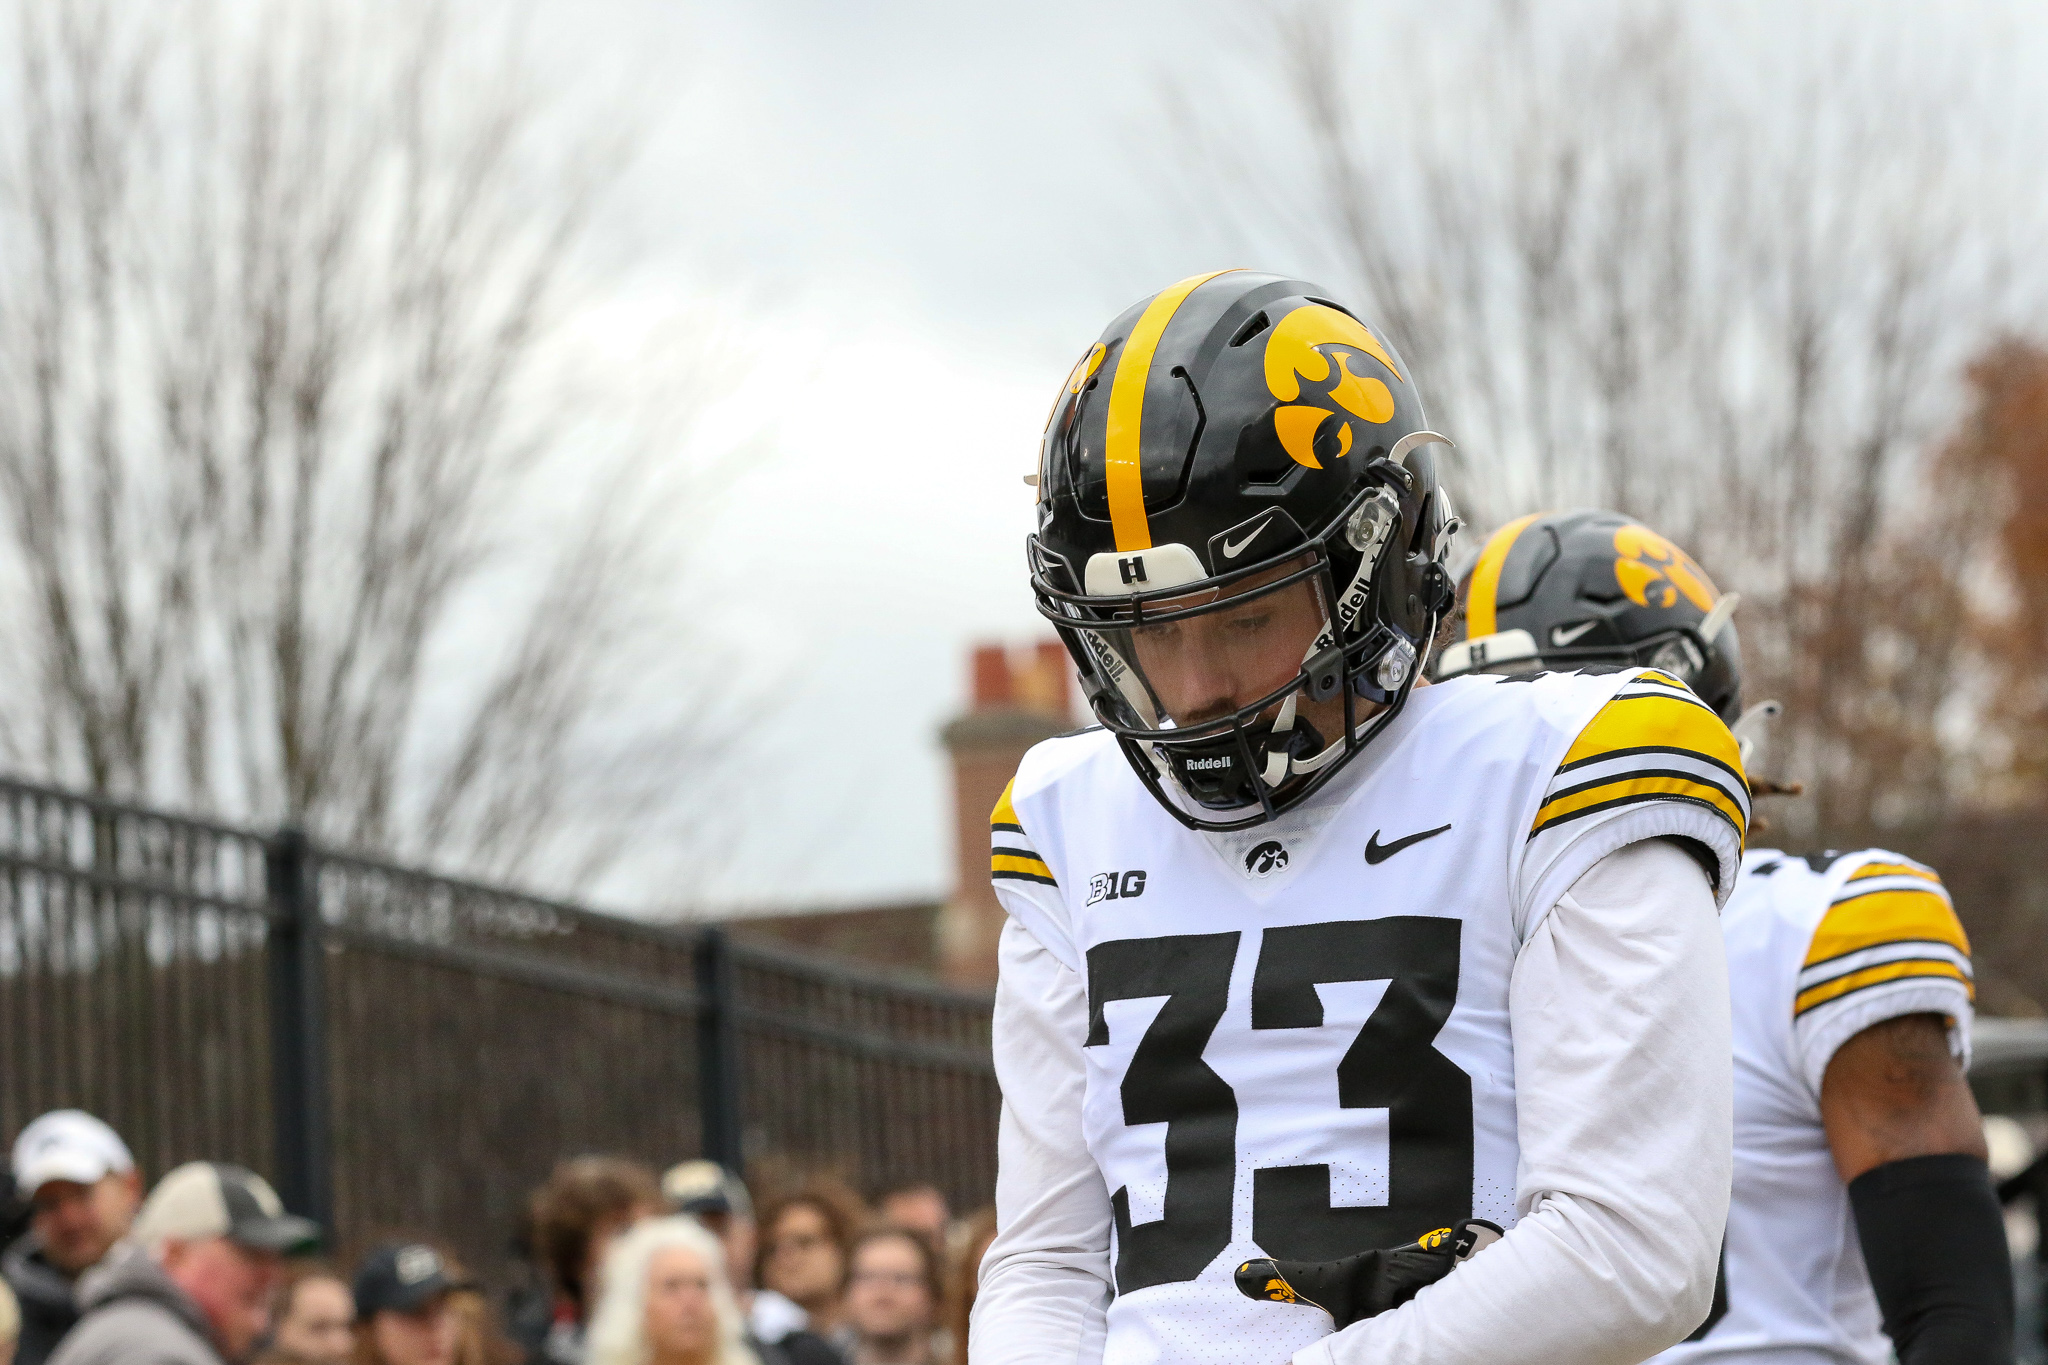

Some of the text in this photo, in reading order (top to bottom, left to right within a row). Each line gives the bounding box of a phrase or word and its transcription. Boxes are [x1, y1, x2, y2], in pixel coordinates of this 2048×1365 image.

[1313, 577, 1371, 650] Rdell
[1186, 756, 1231, 770] Riddell
[1083, 915, 1474, 1298] 33
